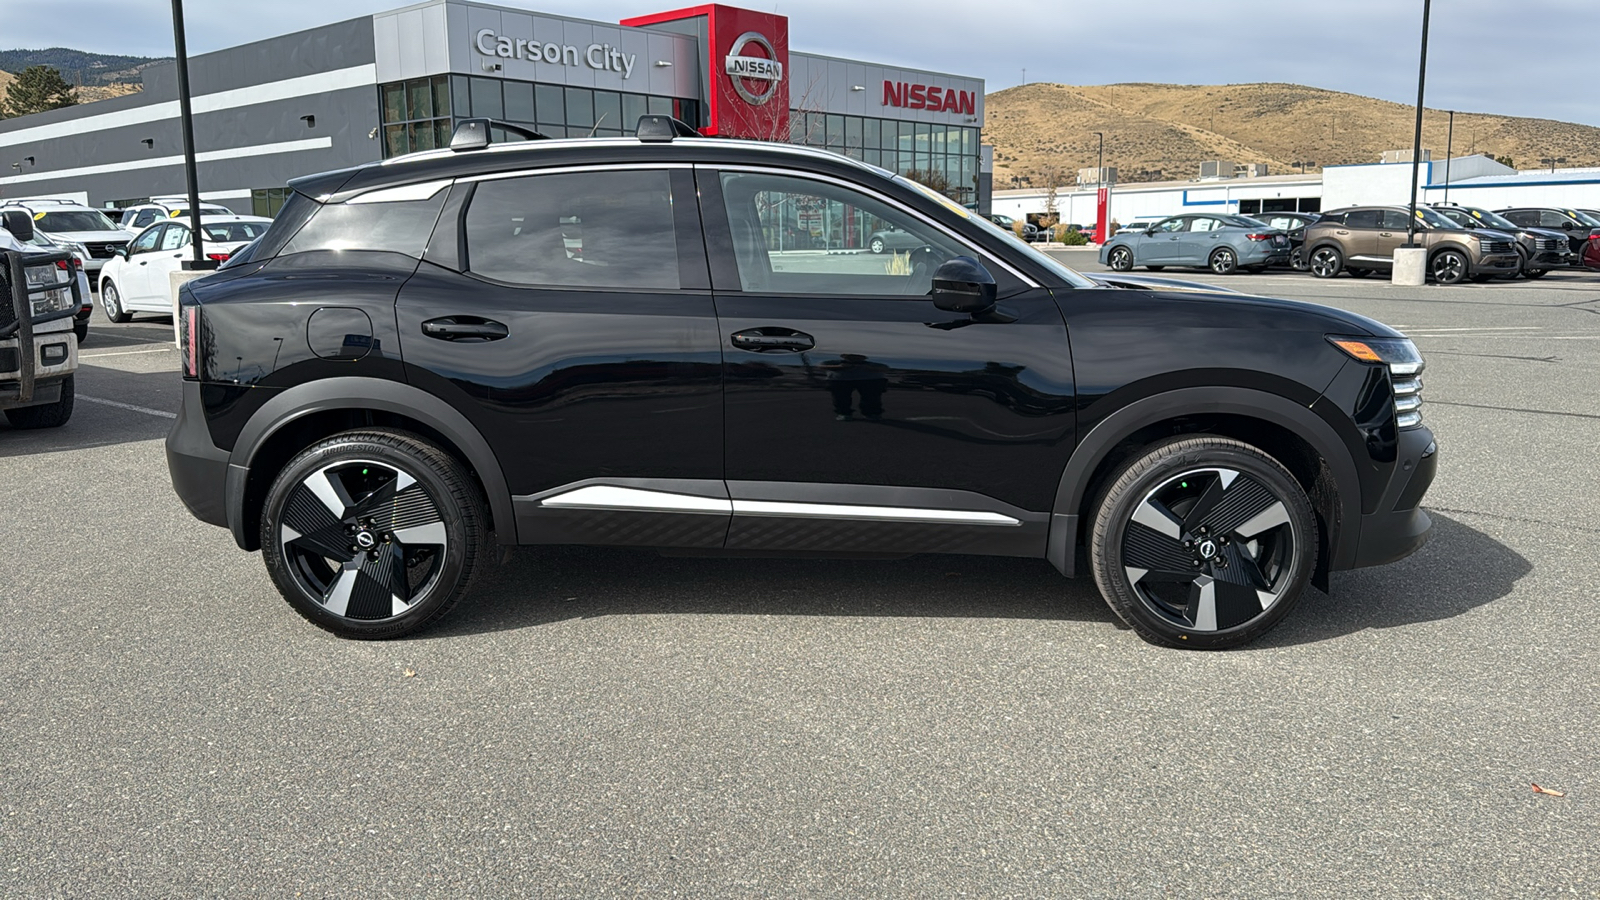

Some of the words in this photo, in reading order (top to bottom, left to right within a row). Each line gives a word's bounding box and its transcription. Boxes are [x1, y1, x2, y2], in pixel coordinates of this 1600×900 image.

[476, 28, 579, 66] Carson
[586, 43, 636, 79] City
[734, 59, 780, 77] NISSAN
[883, 79, 975, 115] NISSAN
